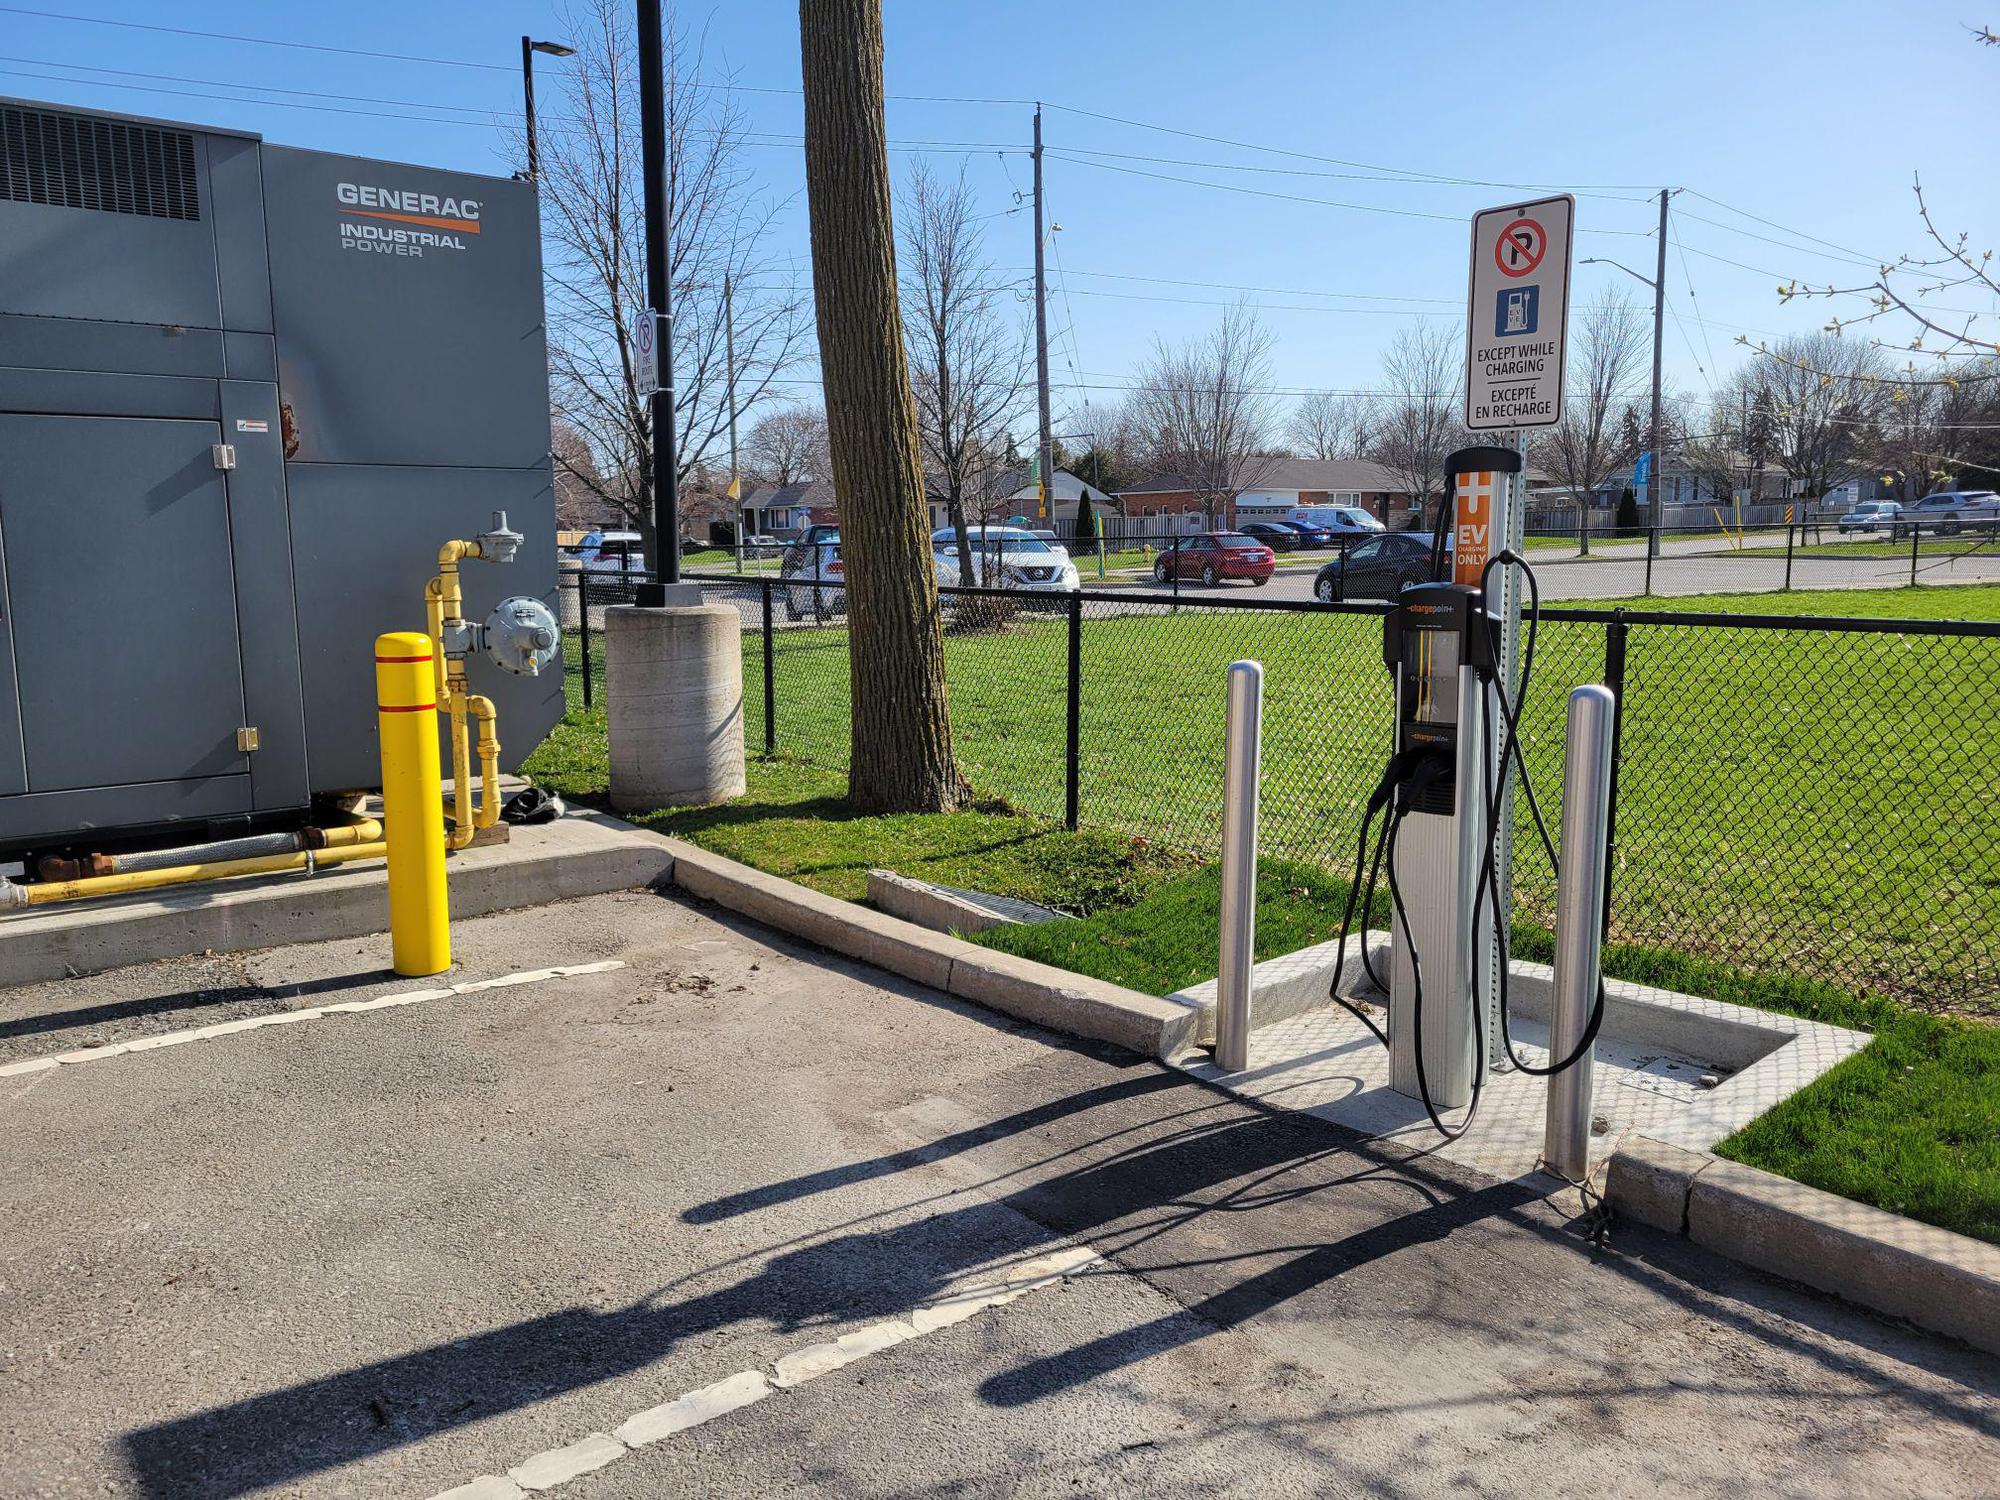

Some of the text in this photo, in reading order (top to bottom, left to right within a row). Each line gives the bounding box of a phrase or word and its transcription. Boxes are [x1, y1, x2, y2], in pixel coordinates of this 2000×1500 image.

[336, 183, 480, 220] GENERAC
[340, 223, 466, 250] INDUSTRIAL
[341, 238, 424, 258] POWER
[1477, 341, 1555, 362] EXCEPT WHILE
[1485, 358, 1544, 377] CHARGING
[1491, 383, 1537, 402] EXCEPTÉ
[1475, 401, 1552, 419] EN RECHARGE
[1458, 524, 1488, 545] EV
[1457, 554, 1487, 565] ONLY
